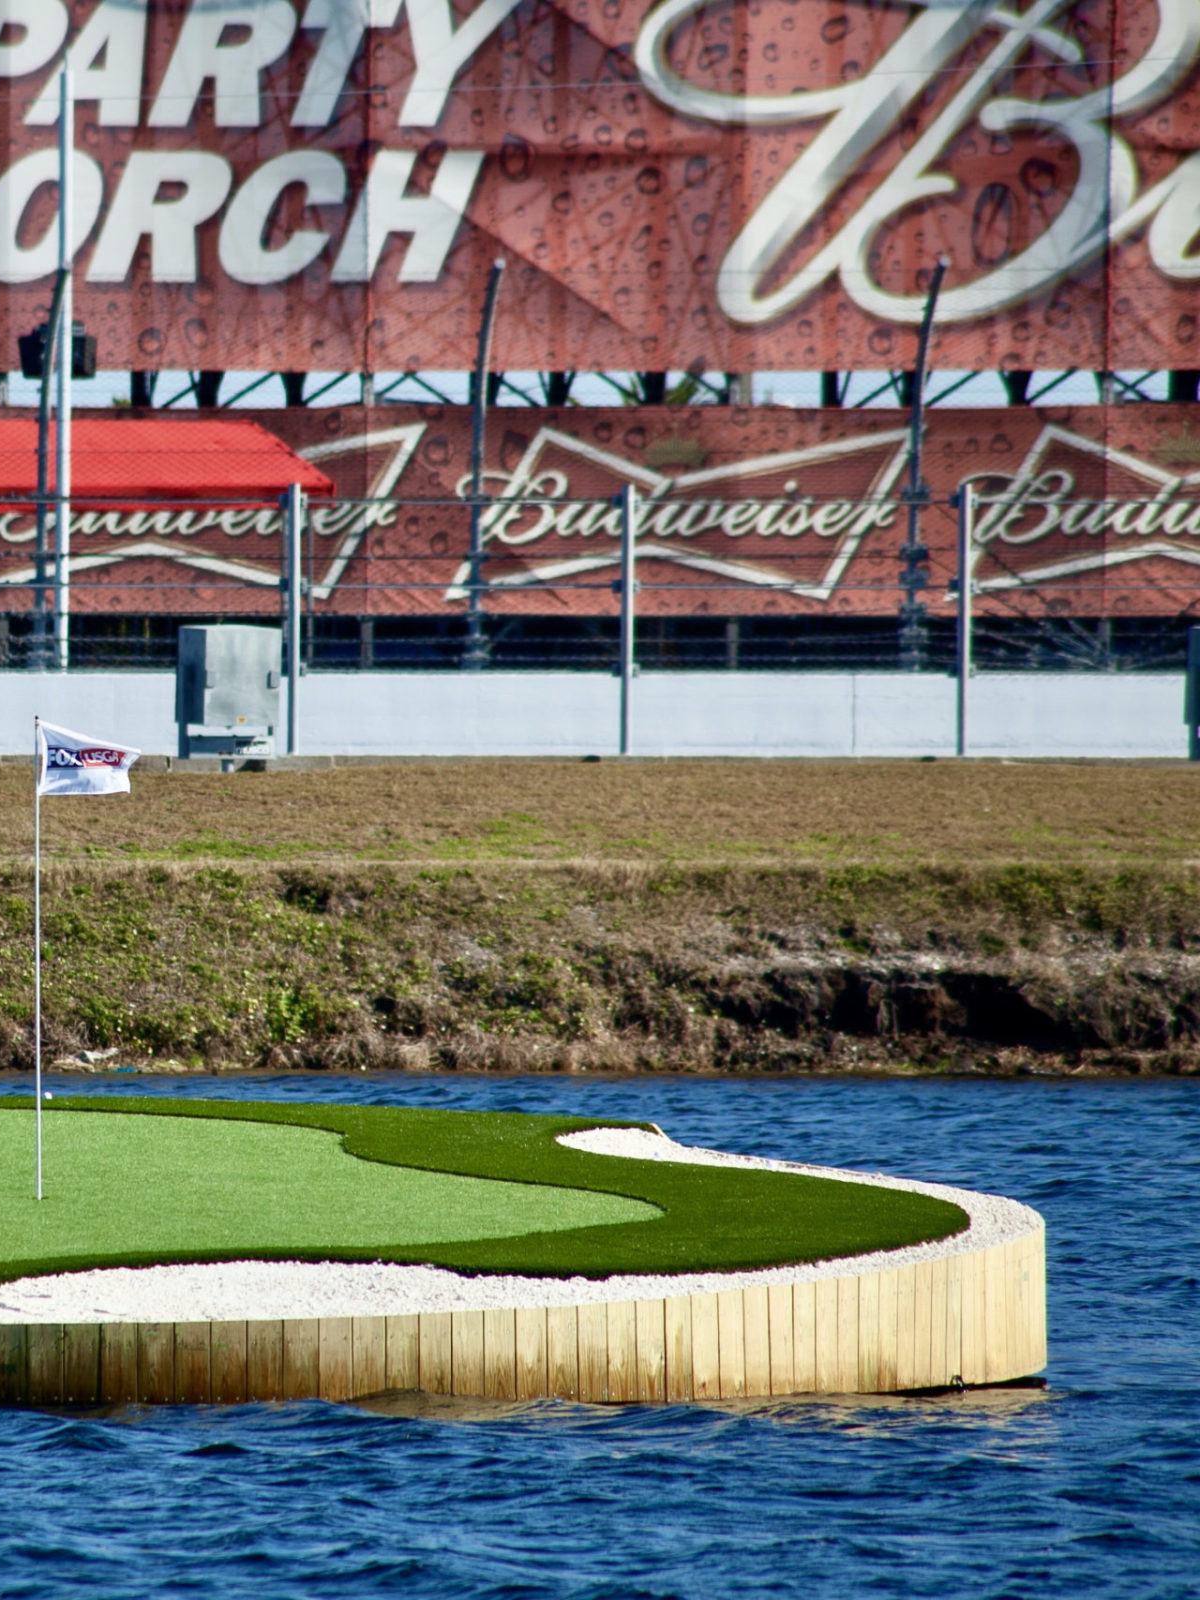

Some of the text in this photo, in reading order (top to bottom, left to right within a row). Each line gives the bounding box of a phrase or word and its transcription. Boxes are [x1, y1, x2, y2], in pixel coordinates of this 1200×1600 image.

[456, 471, 897, 545] Budweiser
[47, 748, 120, 767] FOX USGA
